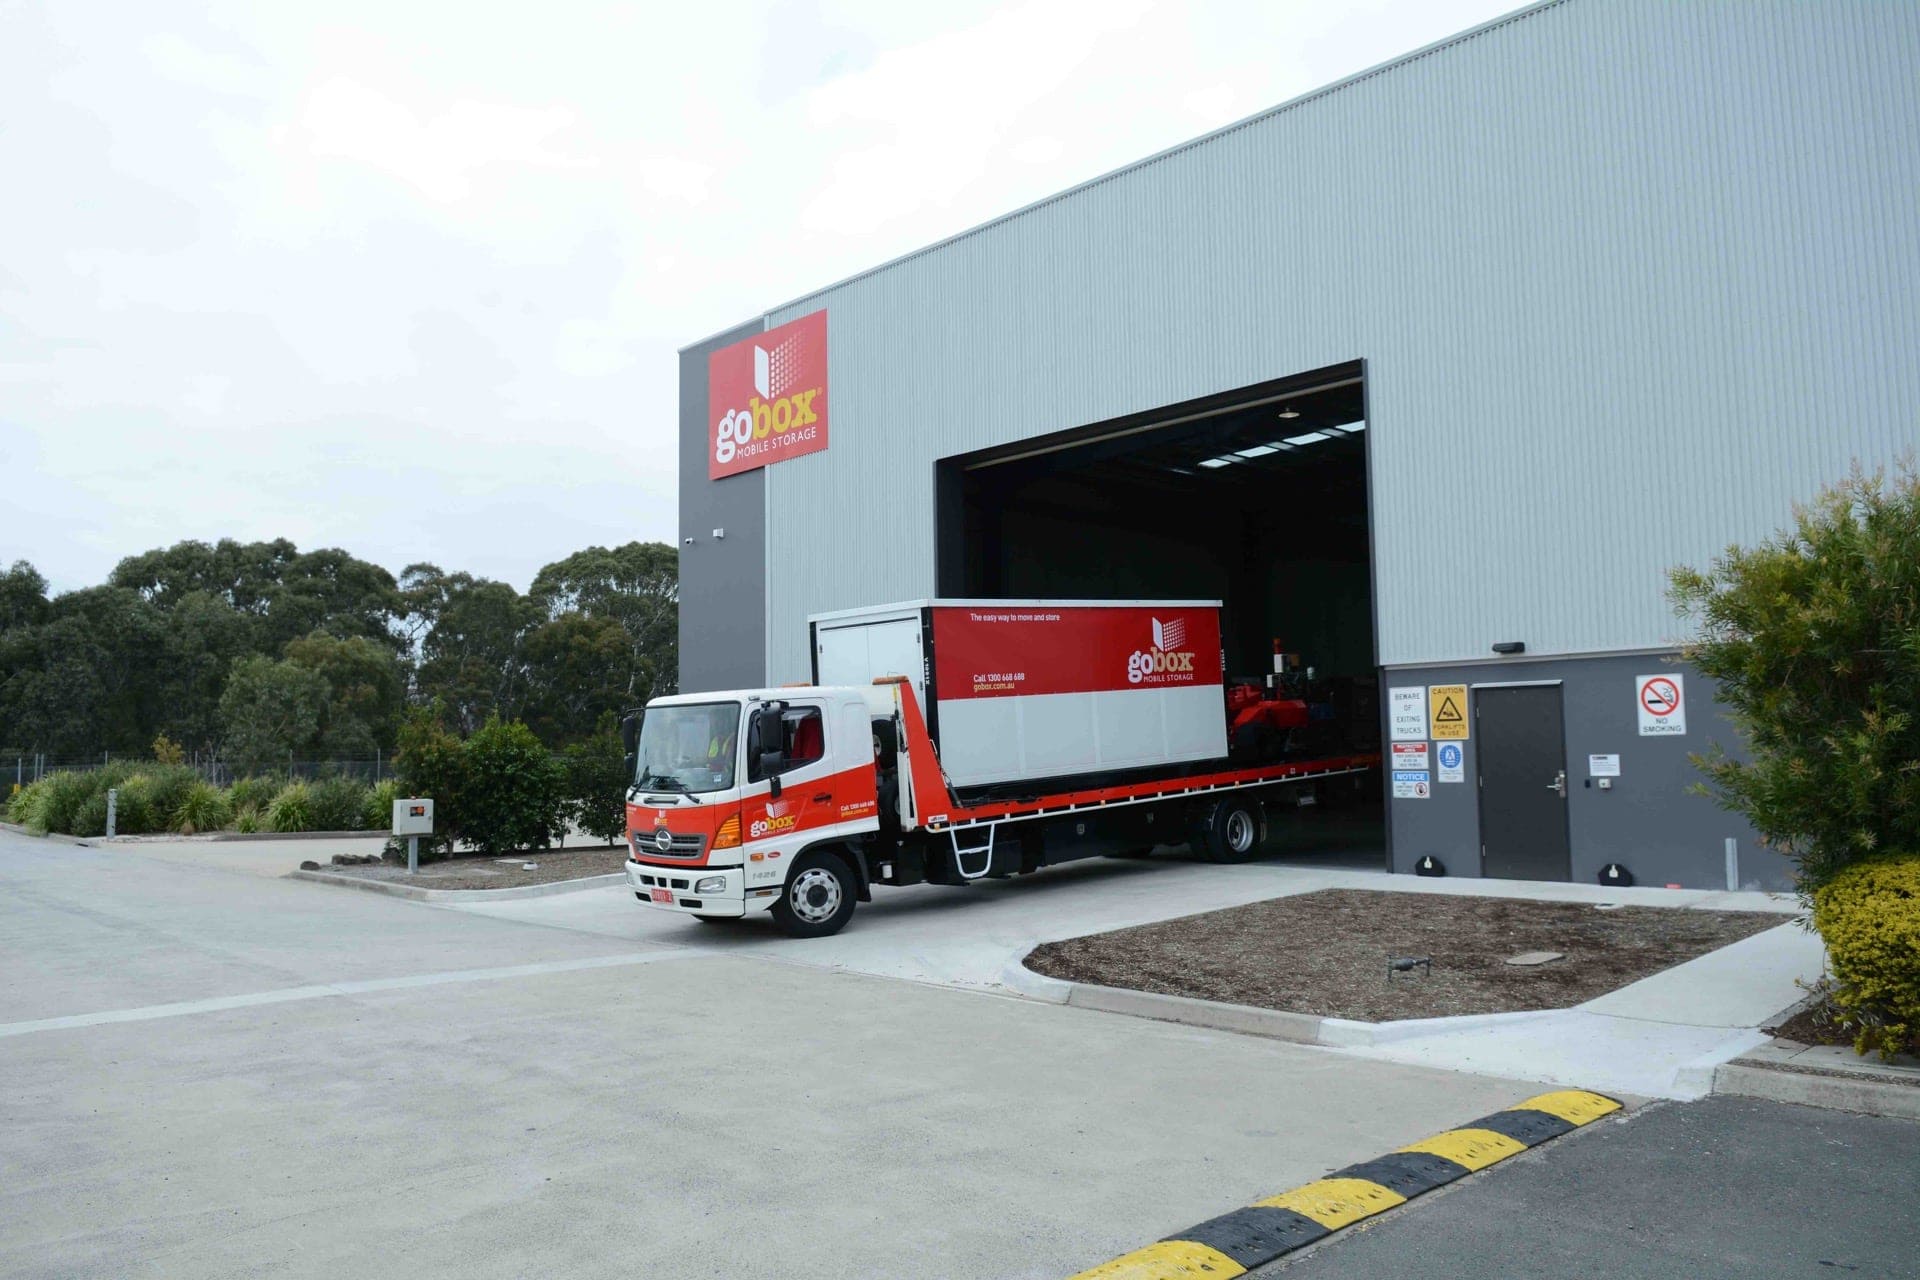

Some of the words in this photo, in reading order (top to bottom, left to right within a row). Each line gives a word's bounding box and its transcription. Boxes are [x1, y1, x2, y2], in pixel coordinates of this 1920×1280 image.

[737, 440, 769, 459] MOBILE
[772, 427, 817, 449] STORAGE
[971, 613, 982, 621] The
[983, 614, 997, 623] easy
[998, 614, 1010, 623] way
[1010, 613, 1017, 621] to
[1045, 613, 1060, 621] store
[1128, 646, 1195, 683] gobox
[973, 674, 986, 682] Call
[987, 673, 1001, 682] 1300
[1167, 673, 1194, 681] STORAGE
[973, 682, 1015, 692] gobox.com.au
[1432, 687, 1464, 695] CAUTION
[1394, 692, 1421, 701] BEWARE
[1396, 715, 1421, 723] EXITING
[1395, 772, 1426, 781] NOTICE
[751, 815, 794, 837] gobox
